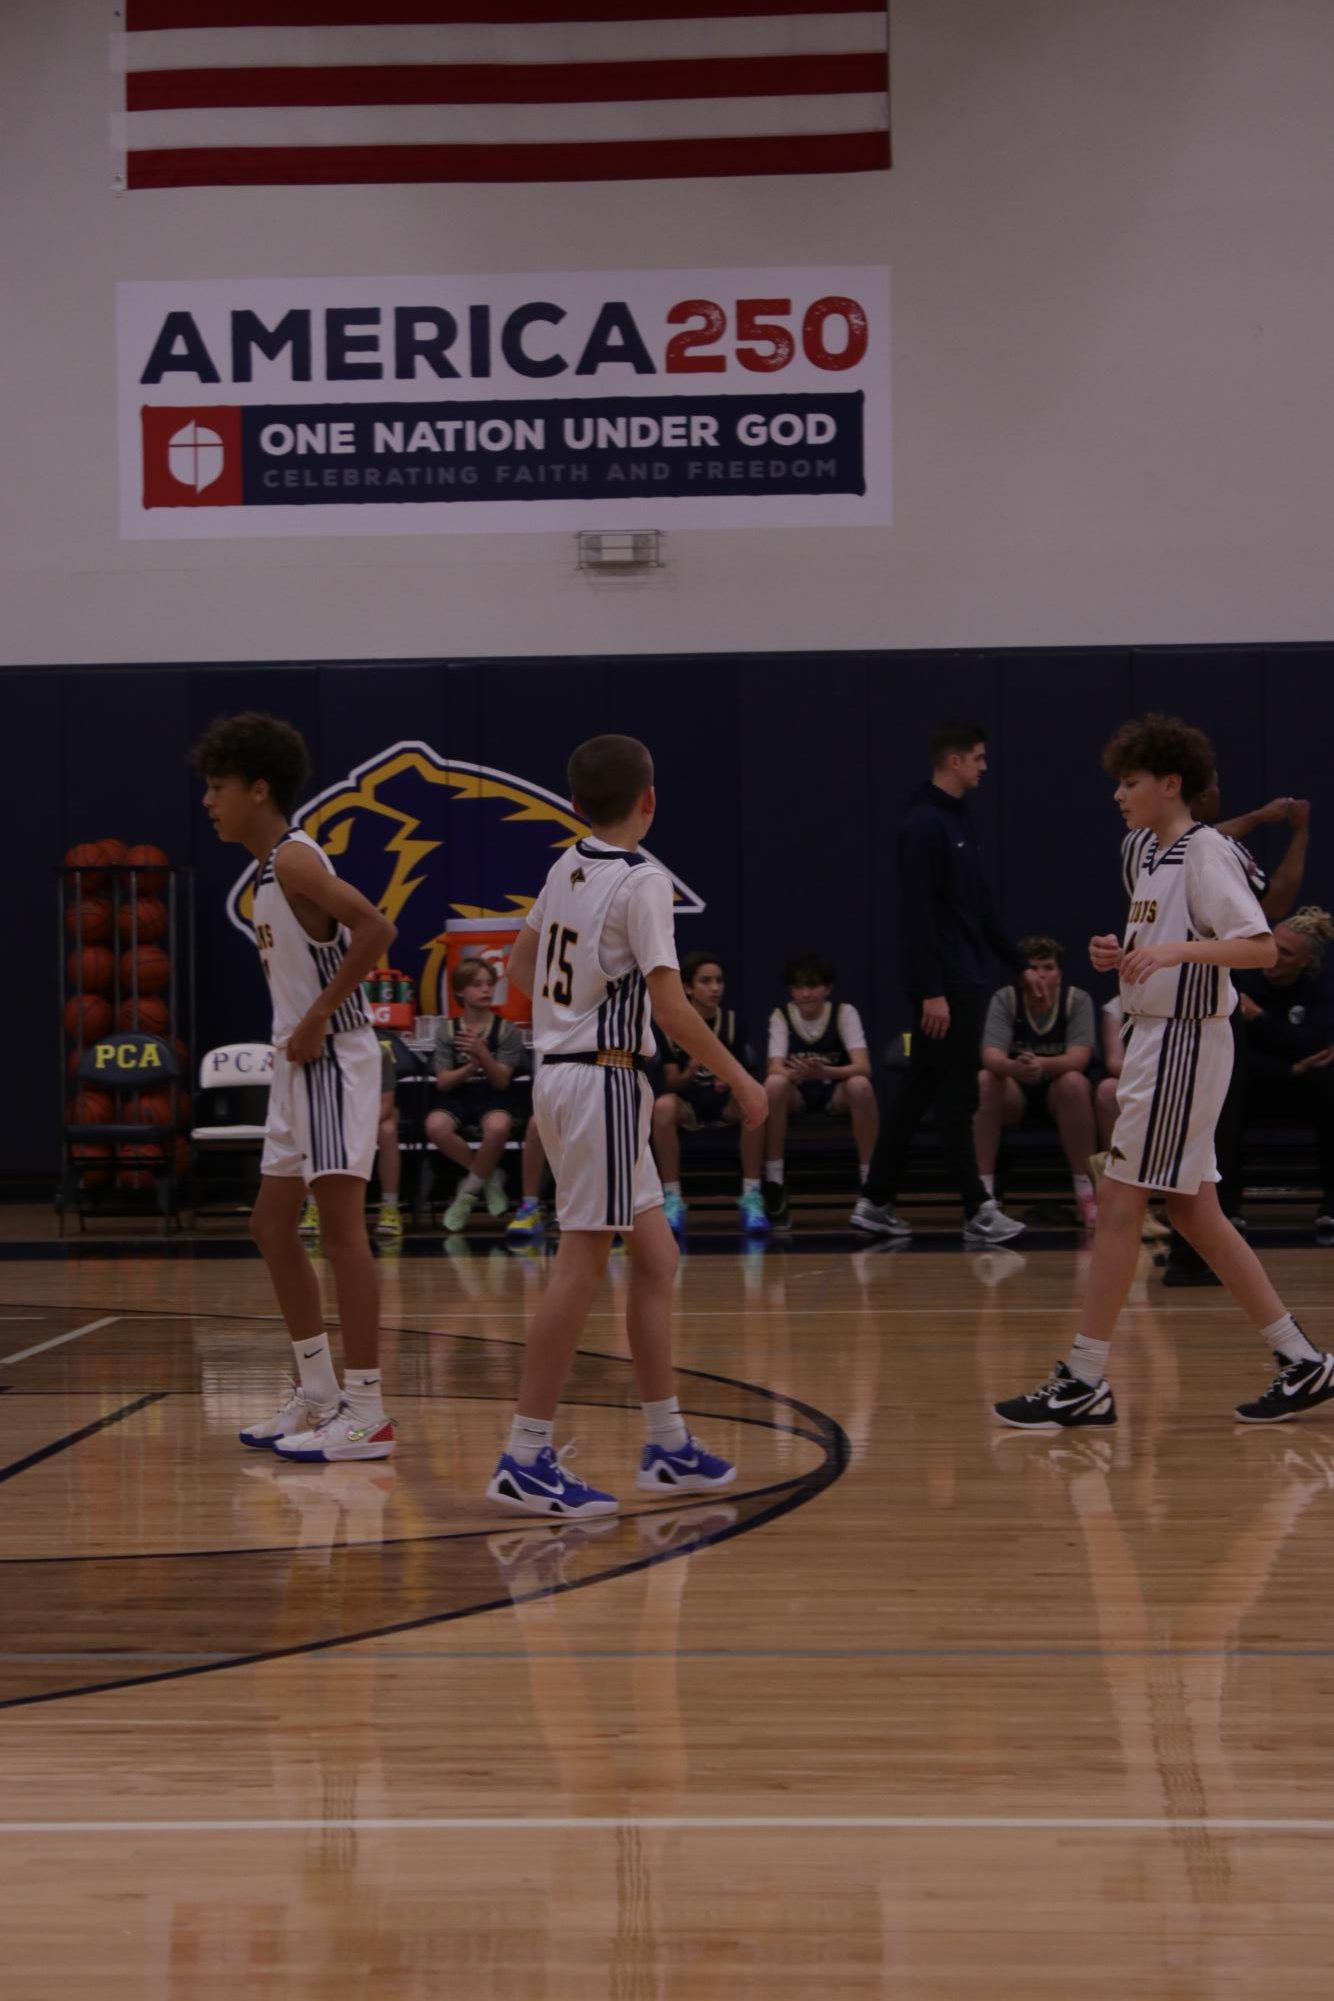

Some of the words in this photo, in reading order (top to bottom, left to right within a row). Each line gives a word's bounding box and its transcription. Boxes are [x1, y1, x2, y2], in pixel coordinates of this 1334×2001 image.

[259, 422, 356, 456] ONE
[373, 418, 546, 454] NATION
[562, 414, 720, 450] UNDER
[736, 412, 838, 447] GOD
[262, 465, 479, 488] CELEBRATING
[495, 463, 589, 484] FAITH
[606, 461, 671, 482] AND
[688, 458, 837, 480] FREEDOM
[542, 922, 578, 1006] 15
[375, 1006, 391, 1023] G
[95, 1043, 162, 1069] PCA
[213, 1051, 275, 1073] PCA
